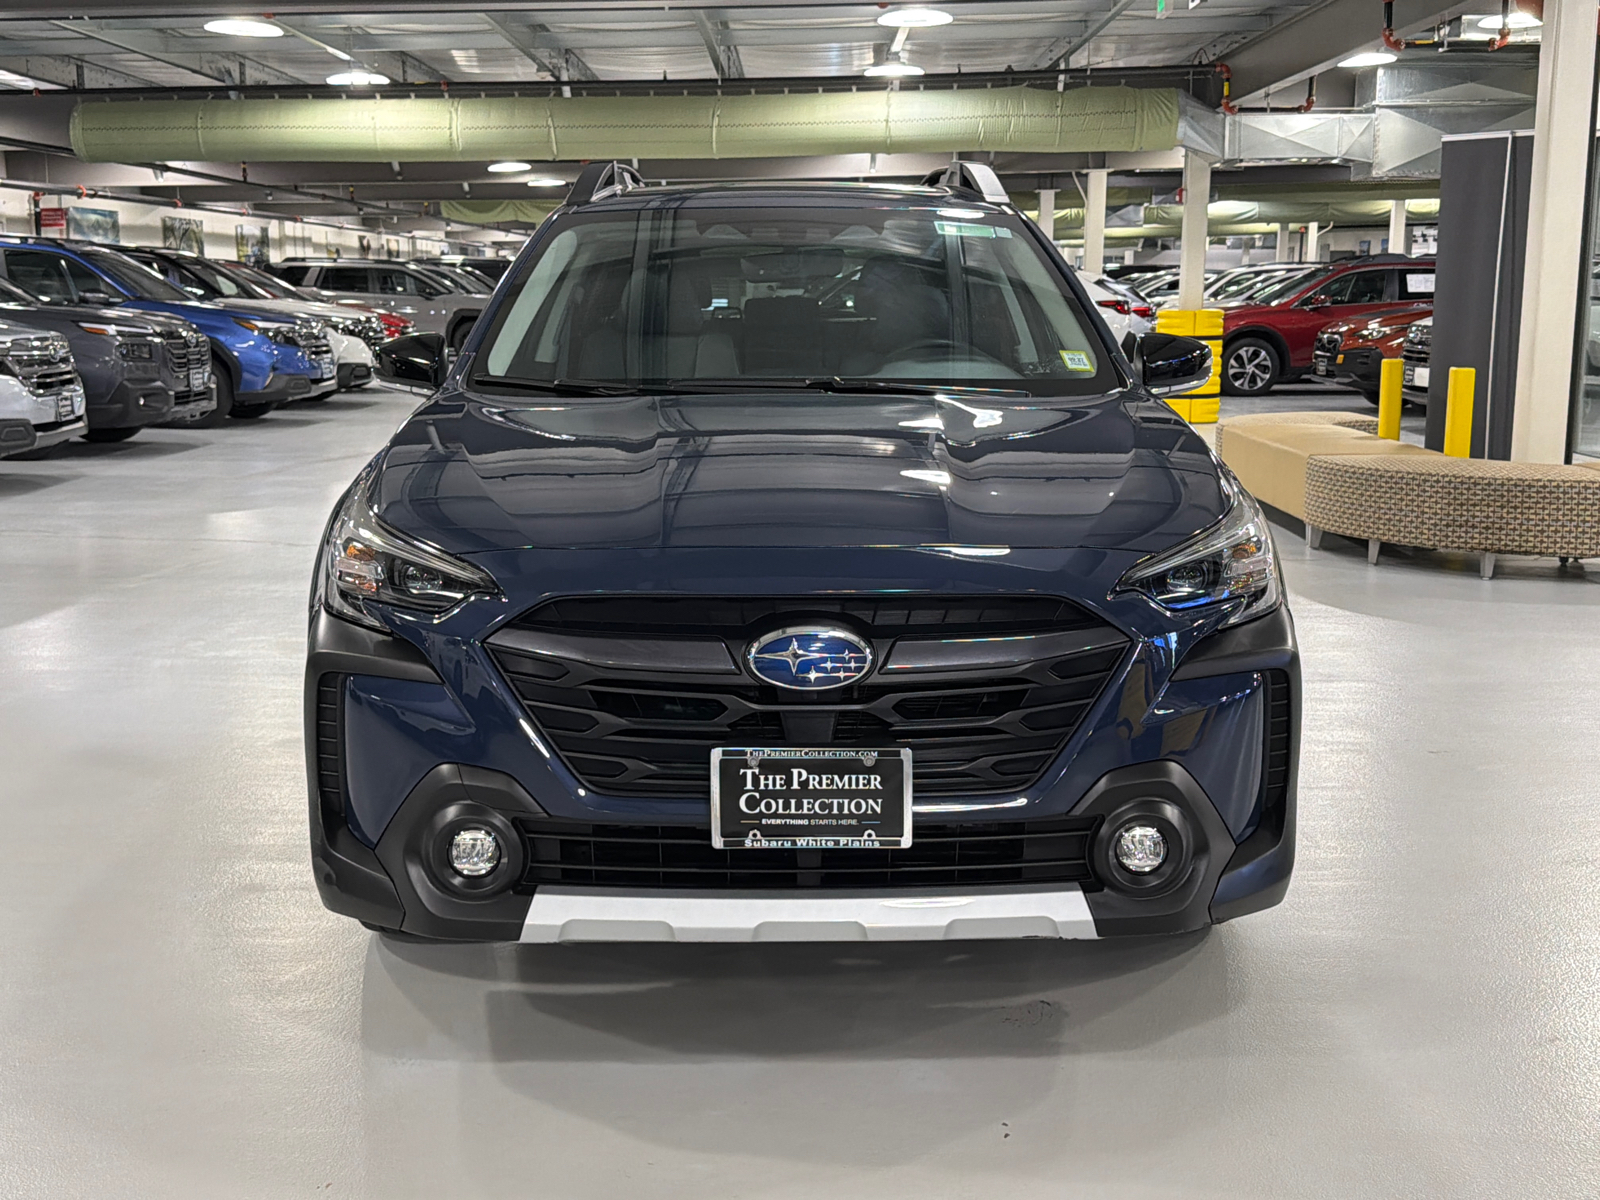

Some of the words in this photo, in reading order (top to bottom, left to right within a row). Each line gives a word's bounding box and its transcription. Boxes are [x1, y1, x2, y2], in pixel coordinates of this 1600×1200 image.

[739, 768, 786, 790] THE
[790, 768, 883, 790] PREMIER
[739, 792, 883, 815] COLLECTION
[745, 839, 791, 848] Subaru
[796, 839, 835, 848] White
[839, 839, 881, 848] Plains
